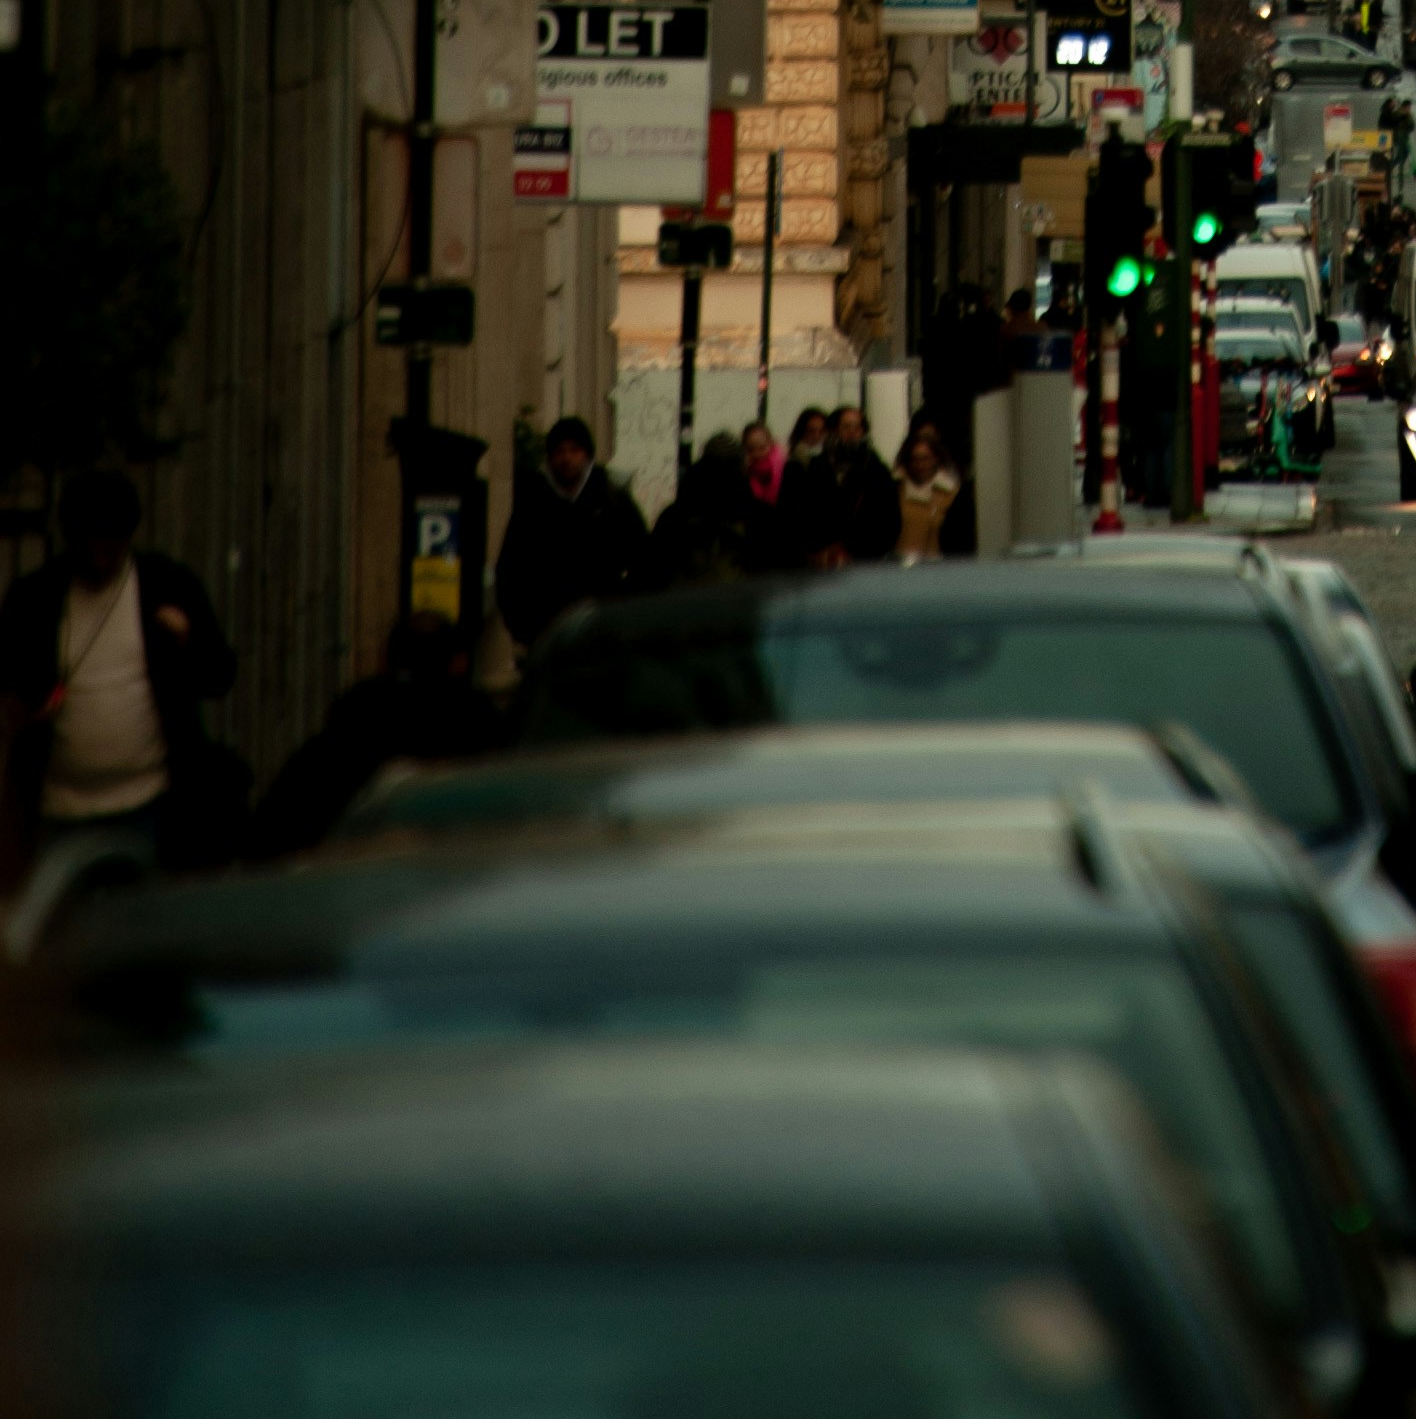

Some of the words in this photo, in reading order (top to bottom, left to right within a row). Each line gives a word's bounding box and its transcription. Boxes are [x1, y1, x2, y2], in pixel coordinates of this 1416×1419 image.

[576, 8, 675, 57] LET
[602, 65, 669, 87] offices
[419, 512, 453, 557] P
